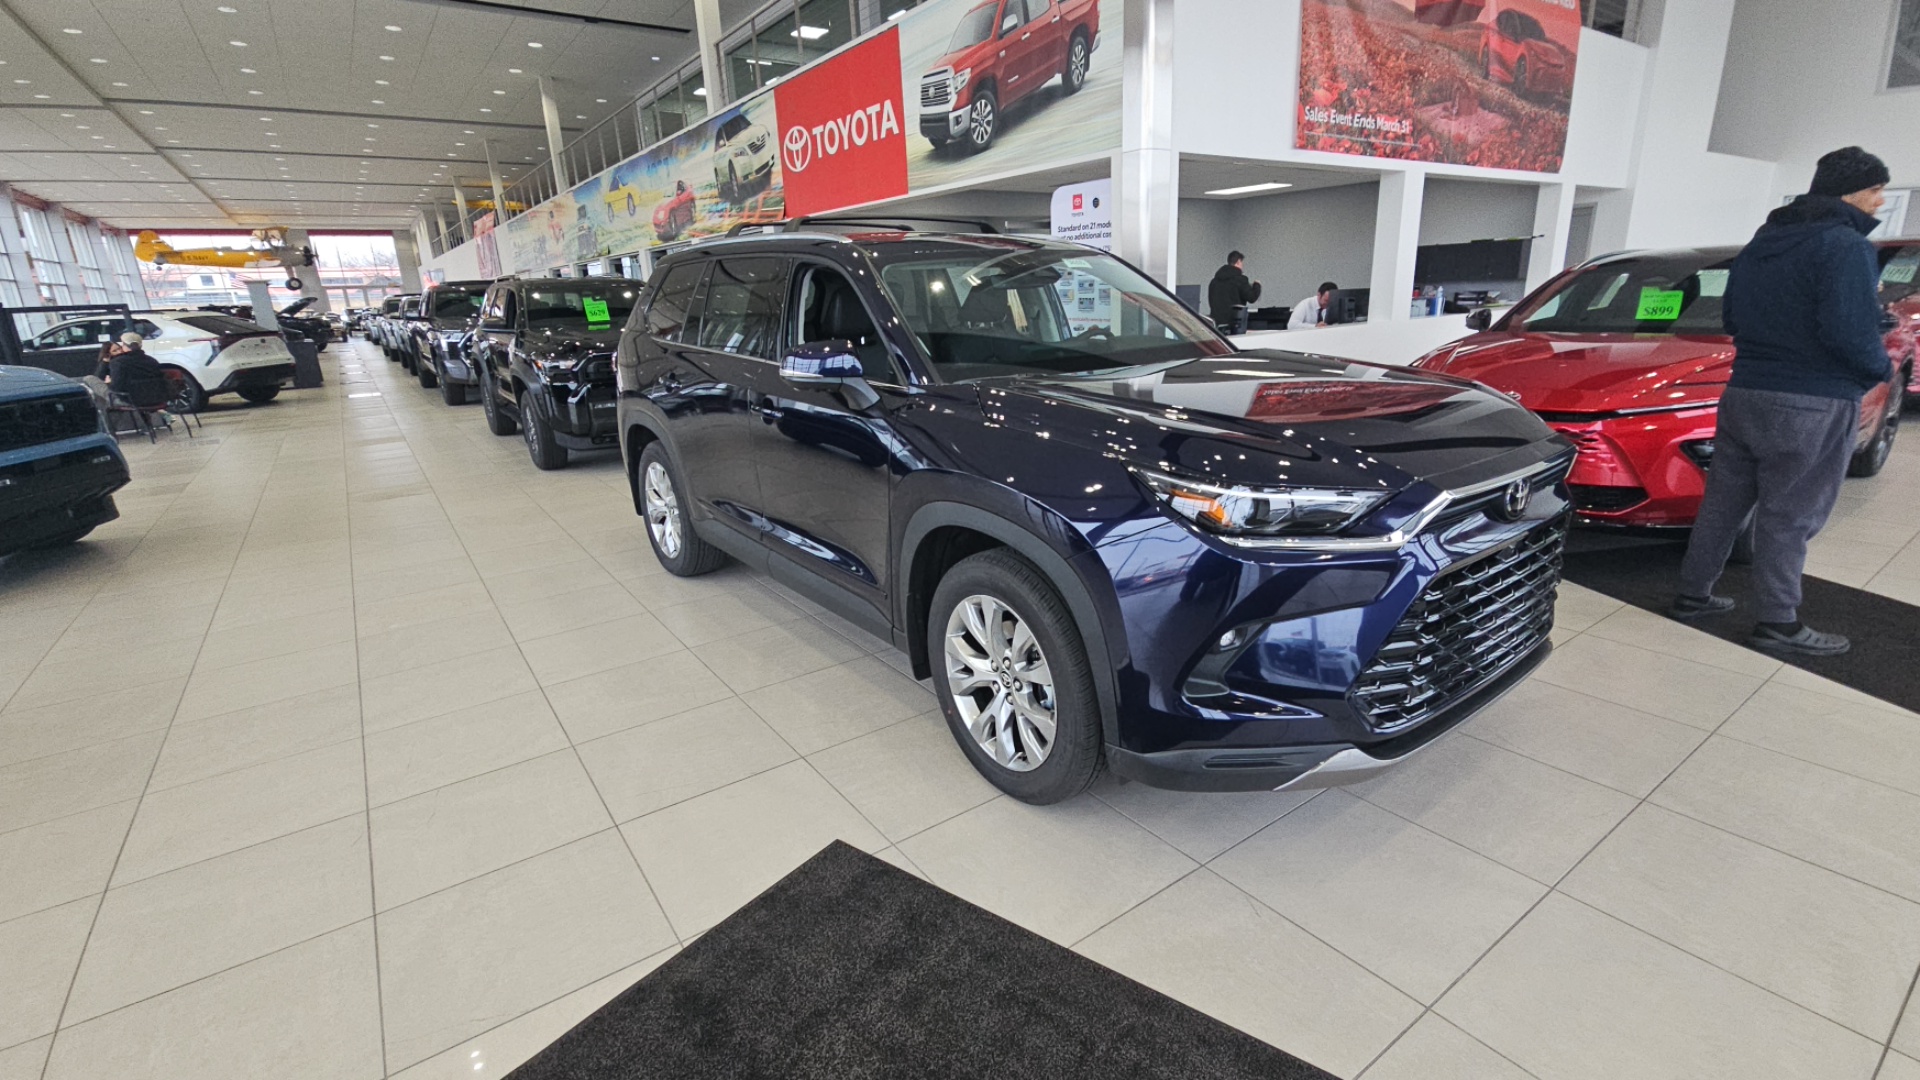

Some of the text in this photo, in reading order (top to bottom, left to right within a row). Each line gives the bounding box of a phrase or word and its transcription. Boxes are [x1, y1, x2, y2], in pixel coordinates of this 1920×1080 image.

[1305, 106, 1328, 122] Sales
[1330, 109, 1352, 126] Event
[1354, 114, 1375, 129] Ends
[1377, 117, 1399, 132] March
[812, 99, 899, 158] TOYOTA
[1057, 224, 1081, 233] Standard
[1090, 222, 1096, 230] 21
[1074, 230, 1101, 240] additional
